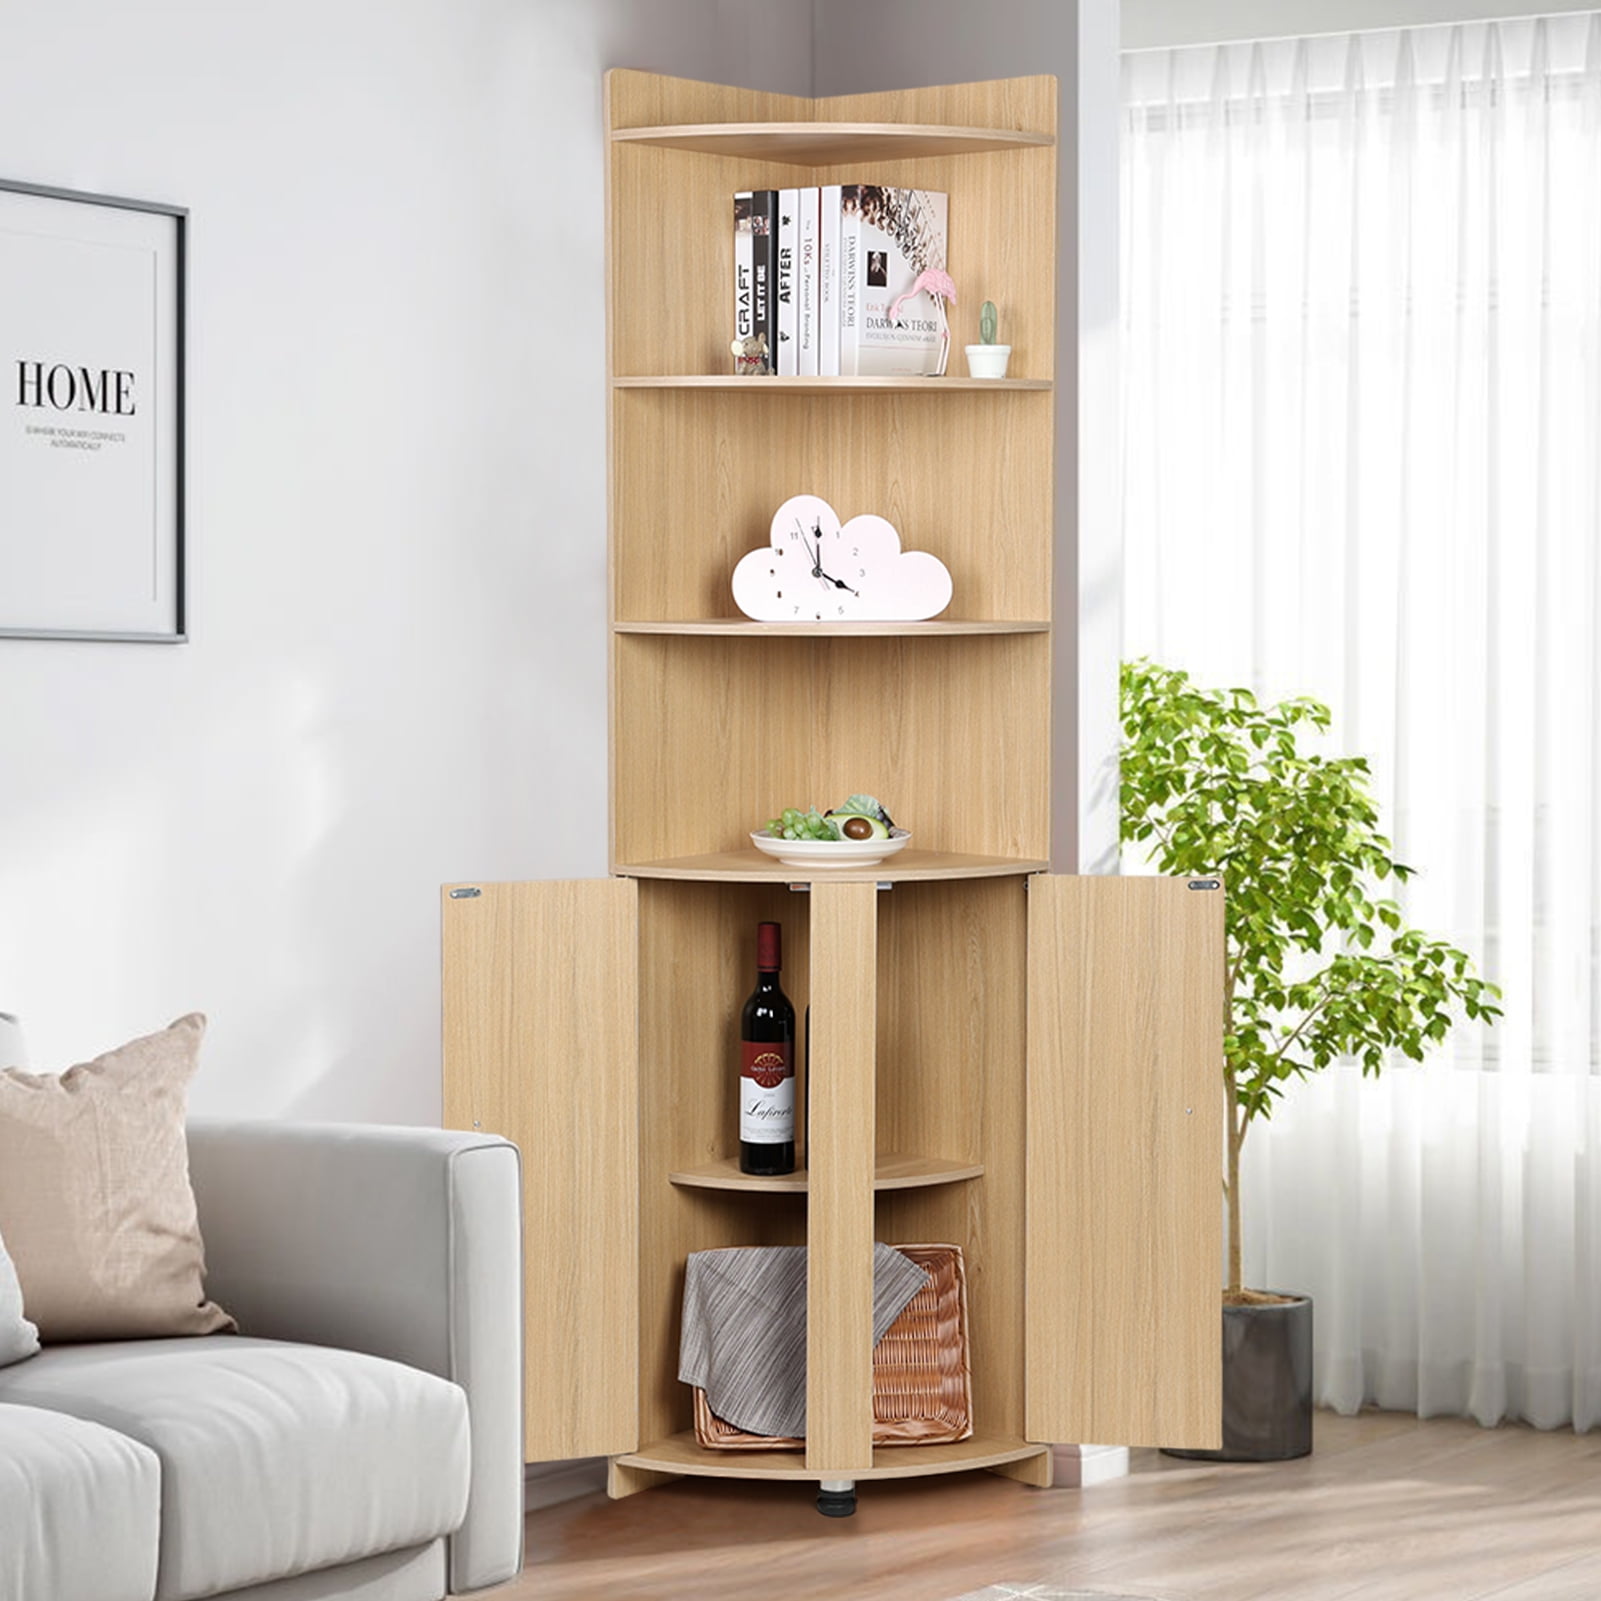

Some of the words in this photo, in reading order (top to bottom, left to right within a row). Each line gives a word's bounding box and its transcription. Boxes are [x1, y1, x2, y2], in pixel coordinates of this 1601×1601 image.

[847, 235, 856, 291] DARWINS
[756, 265, 766, 282] BE
[779, 247, 792, 304] AFTER
[738, 265, 751, 336] CRAFT
[756, 284, 766, 297] IT
[803, 274, 811, 311] Personal
[756, 298, 766, 321] LET
[847, 293, 856, 328] TEORI
[802, 313, 811, 350] Branding
[910, 319, 937, 332] TEORI
[16, 359, 136, 416] HOME
[790, 531, 799, 540] 11
[852, 547, 859, 556] 2
[859, 568, 866, 577] 3
[794, 606, 800, 614] 7
[838, 605, 845, 615] 5
